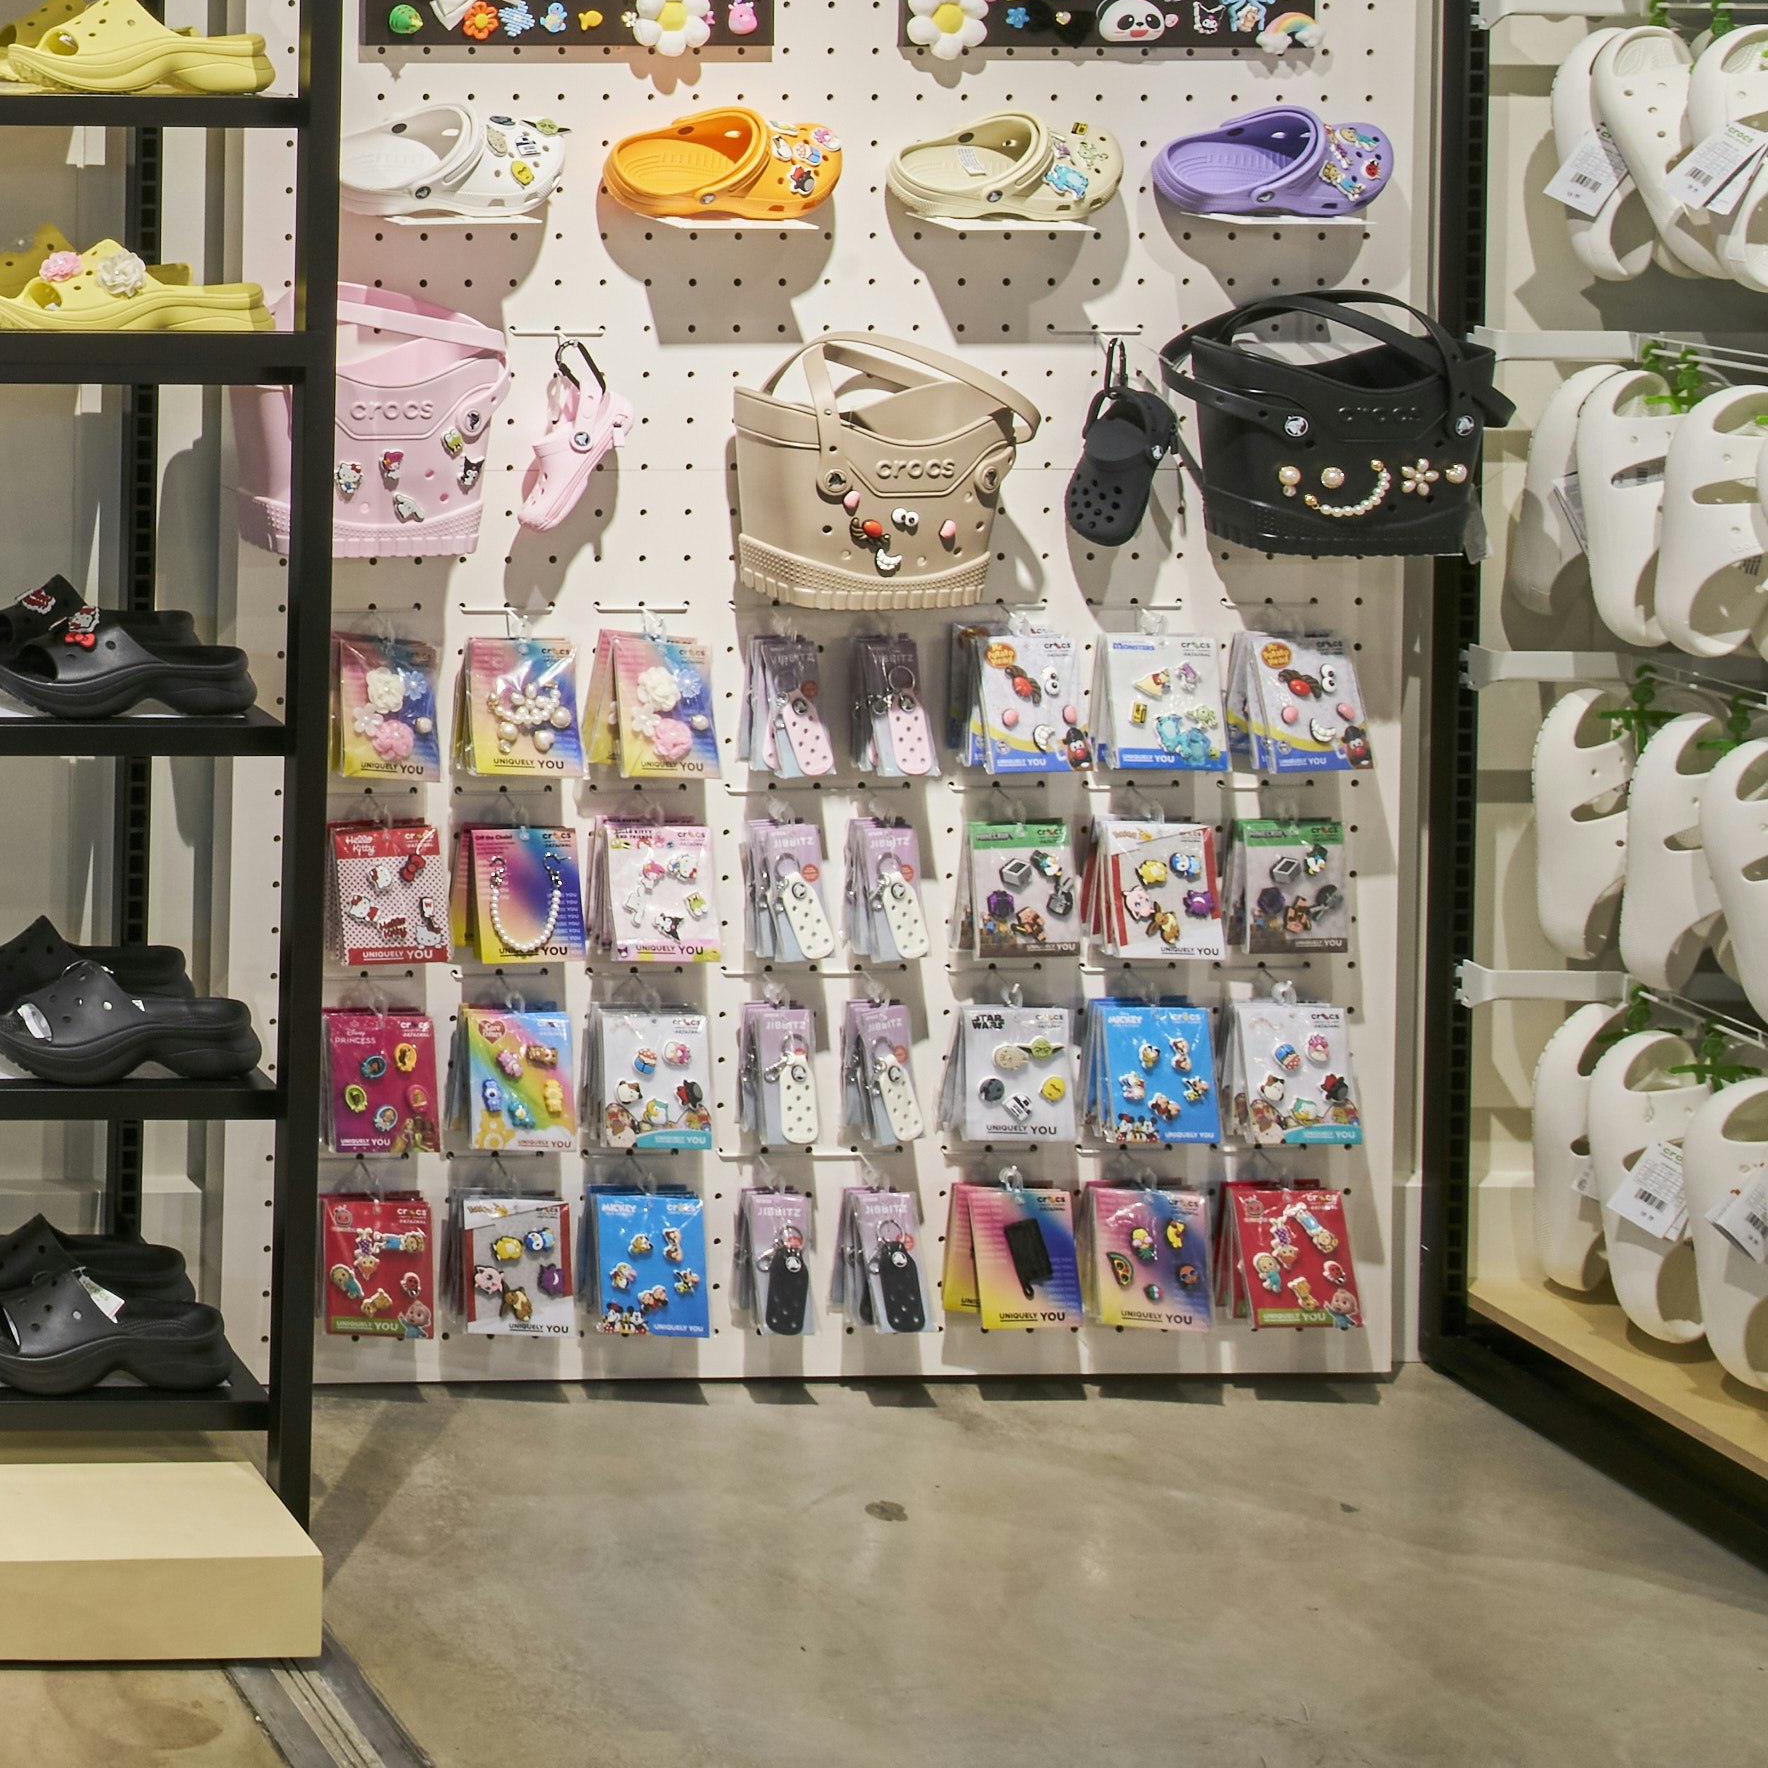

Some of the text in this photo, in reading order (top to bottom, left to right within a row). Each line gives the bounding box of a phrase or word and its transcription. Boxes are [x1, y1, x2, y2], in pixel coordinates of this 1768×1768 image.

[1727, 125, 1755, 144] crocs
[349, 397, 434, 421] crocs
[1338, 404, 1423, 423] crocs
[875, 454, 955, 479] crocs
[1027, 757, 1047, 766] YOU
[1154, 754, 1176, 763] YOU
[1309, 756, 1327, 765] YOU
[493, 757, 564, 770] UNIQUELY YOU
[680, 761, 704, 772] YOU
[400, 764, 424, 775] YOU
[1056, 943, 1076, 951] YOU
[1324, 939, 1343, 947] YOU
[362, 949, 433, 959] UNIQUELY YOU
[542, 946, 568, 956] YOU
[635, 944, 704, 955] UNIQUELY YOU
[1197, 947, 1219, 956] YOU
[971, 1014, 1005, 1022] STAR
[971, 1021, 1006, 1030] WARS
[334, 1036, 376, 1044] PRINCESS
[986, 1124, 1057, 1135] UNIQUELY YOU
[1335, 1130, 1356, 1138] YOU
[371, 1138, 391, 1146] YOU
[551, 1140, 572, 1149] YOU
[686, 1136, 707, 1145] YOU
[1662, 1146, 1683, 1163] cro
[999, 1312, 1066, 1321] UNIQUELY YOU
[1121, 1310, 1192, 1325] UNIQUELY YOU
[1303, 1312, 1326, 1321] YOU
[374, 1321, 400, 1331] YOU
[509, 1323, 569, 1334] UNIQUELY YOU
[688, 1325, 704, 1333] YOU
